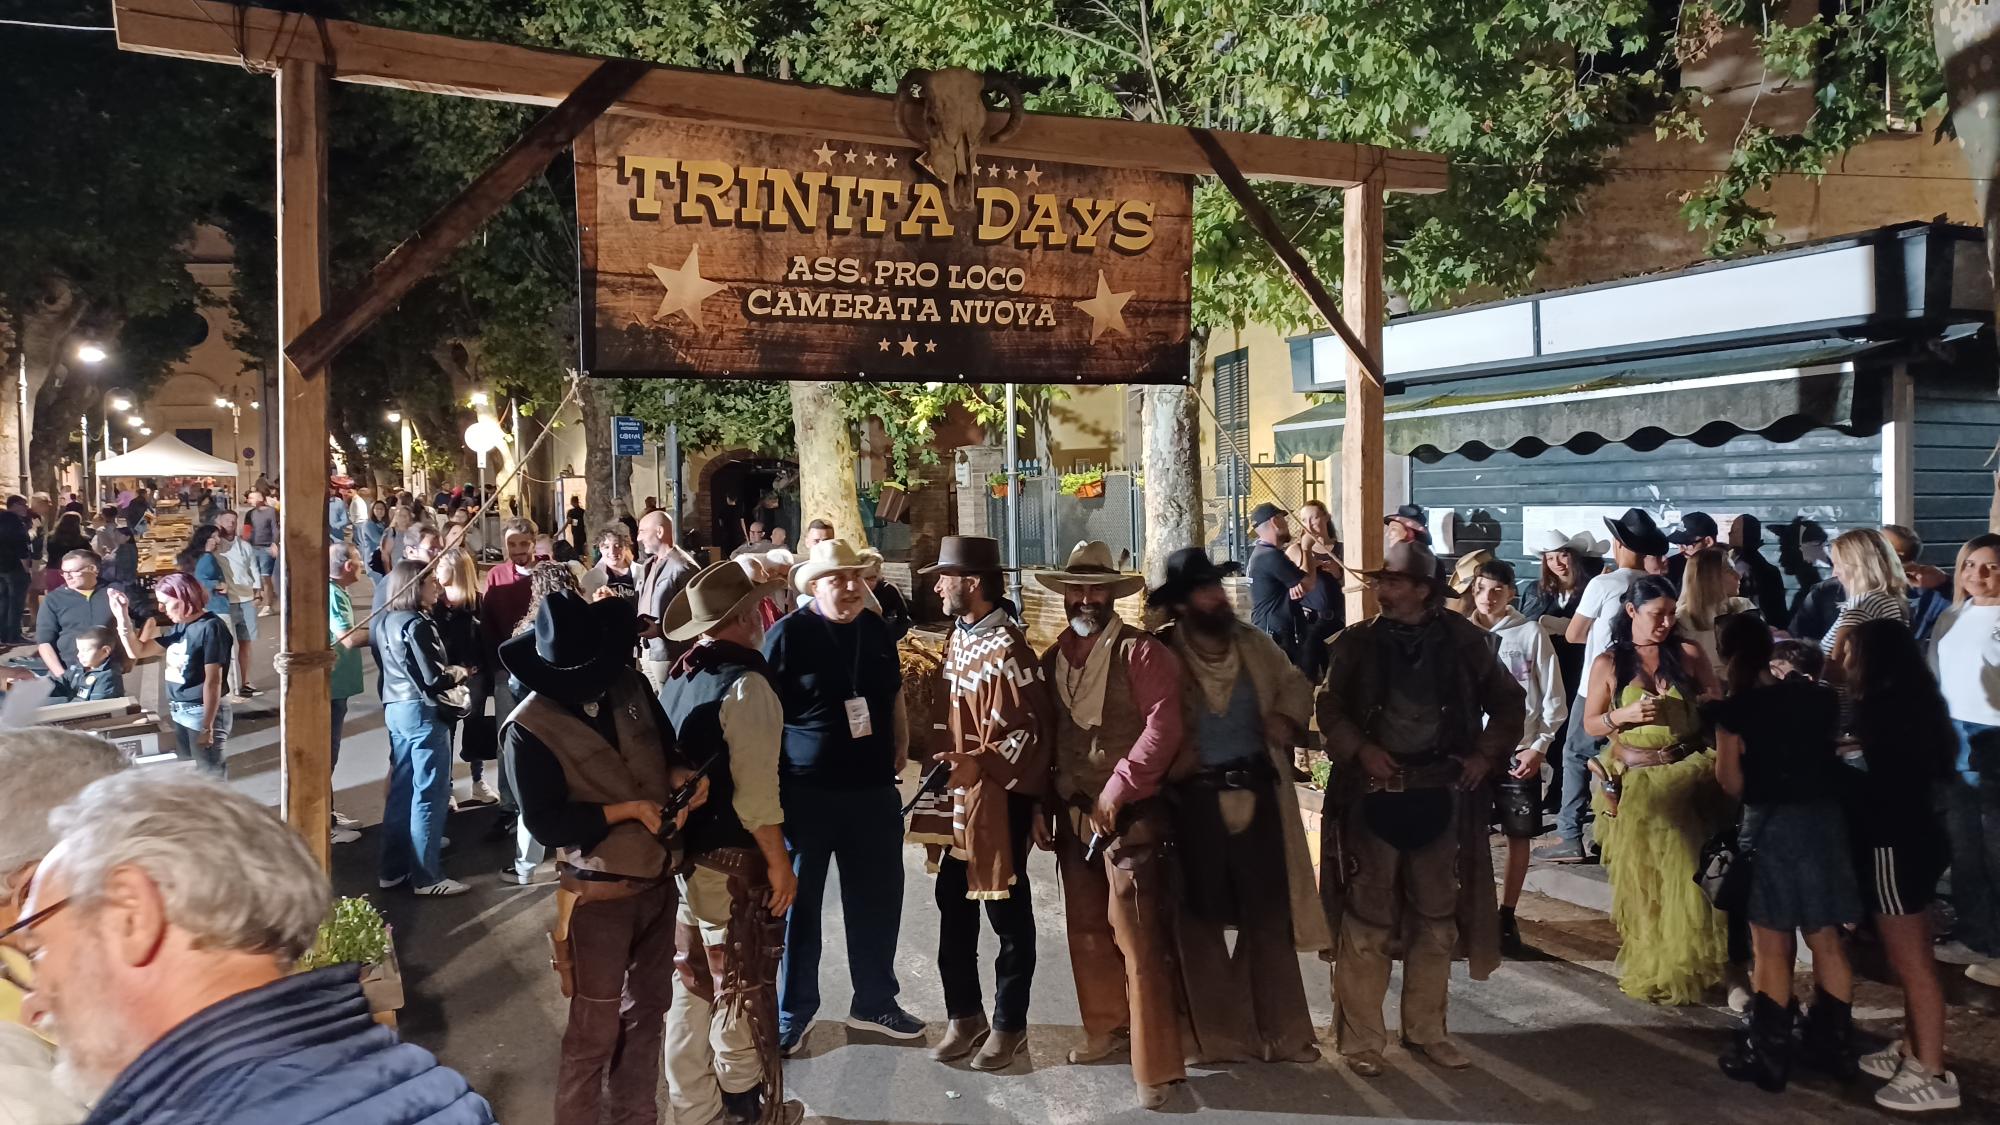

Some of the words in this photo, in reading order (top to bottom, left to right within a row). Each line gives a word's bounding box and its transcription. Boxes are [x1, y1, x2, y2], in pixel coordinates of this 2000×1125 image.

[622, 154, 955, 237] TRINITA
[976, 186, 1156, 250] DAYS
[788, 255, 867, 285] ASS.
[874, 260, 940, 288] PRO
[948, 265, 1026, 292] LOCO
[748, 289, 941, 322] CAMERATA
[950, 299, 1057, 327] NUOVA
